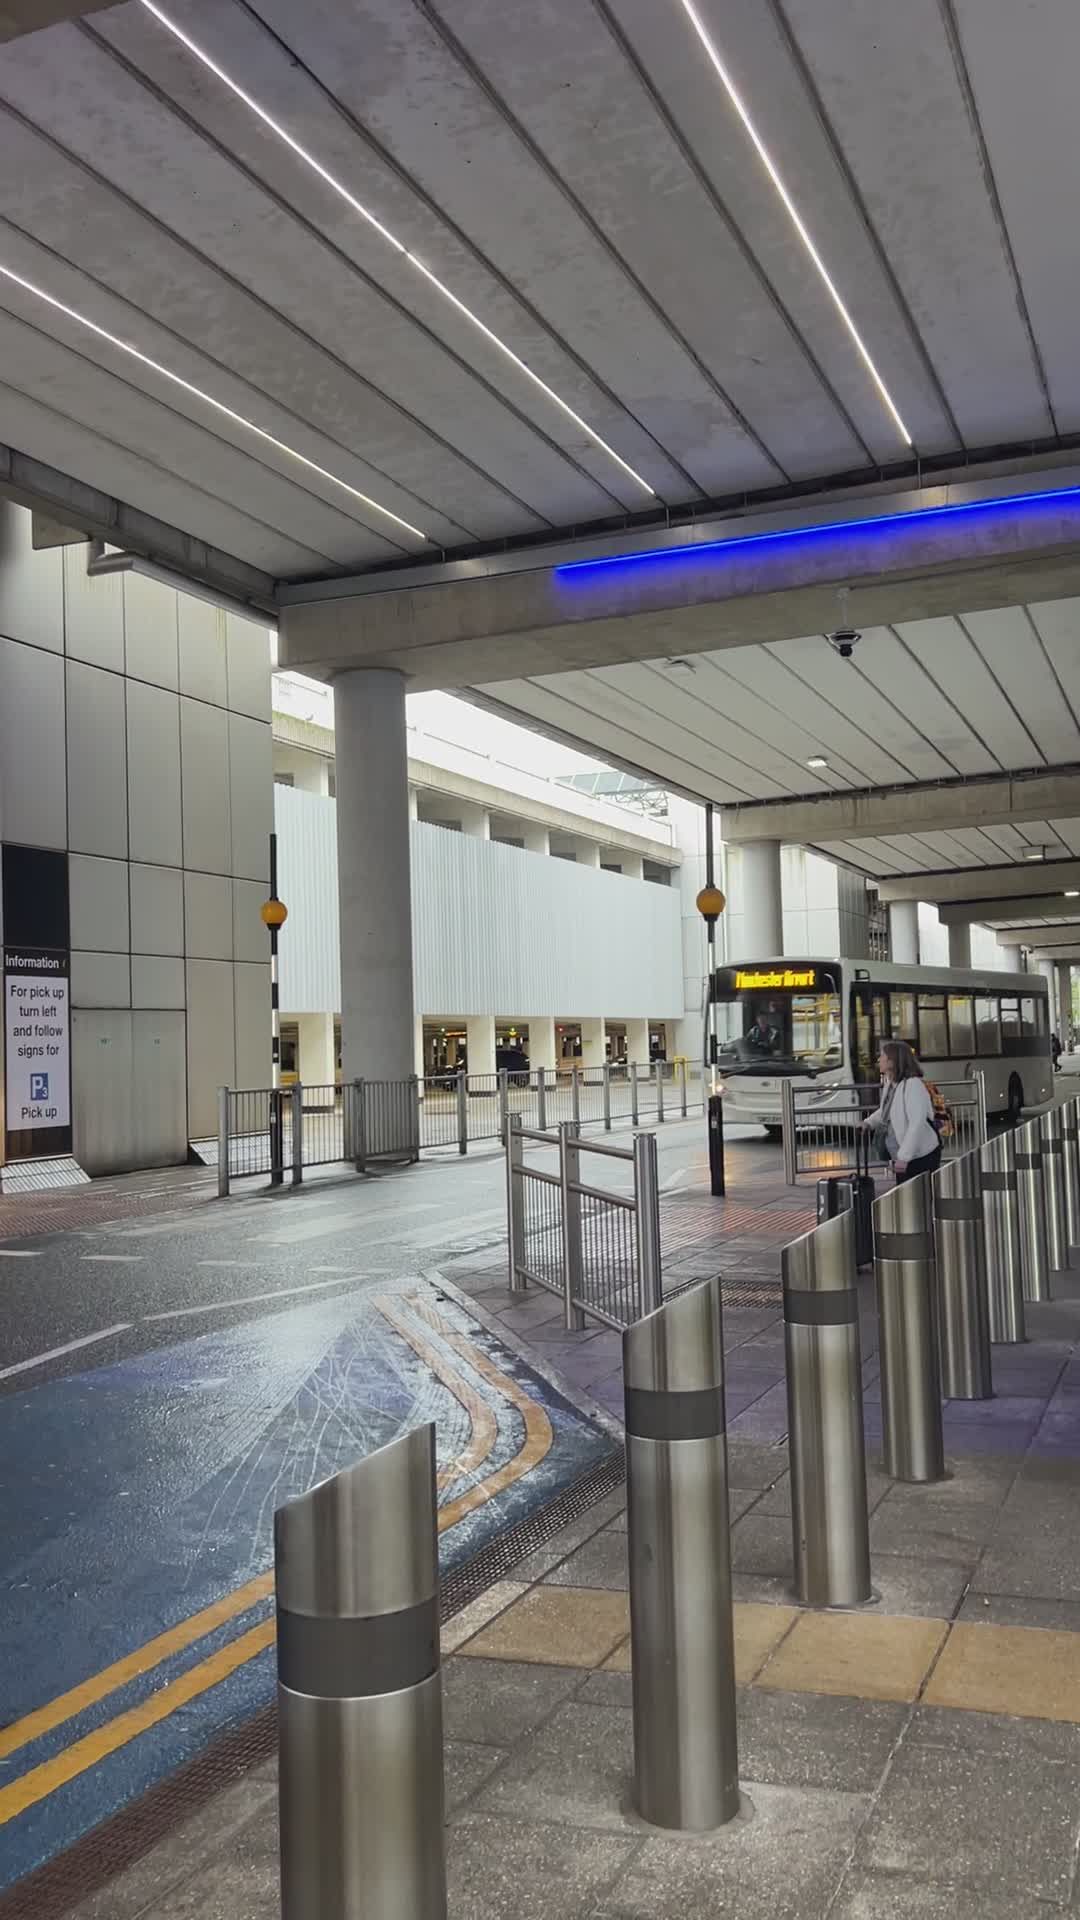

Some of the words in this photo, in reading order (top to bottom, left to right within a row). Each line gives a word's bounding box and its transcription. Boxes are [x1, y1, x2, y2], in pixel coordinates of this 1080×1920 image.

[6, 955, 59, 968] Information
[10, 985, 27, 997] For
[30, 986, 50, 1000] pick
[53, 989, 64, 1000] up
[19, 1005, 40, 1017] turn
[42, 1005, 57, 1017] left
[13, 1025, 32, 1037] and
[34, 1024, 63, 1037] follow
[18, 1044, 44, 1059] signs
[46, 1044, 60, 1055] for
[21, 1106, 43, 1120] Pick
[46, 1107, 57, 1119] up
